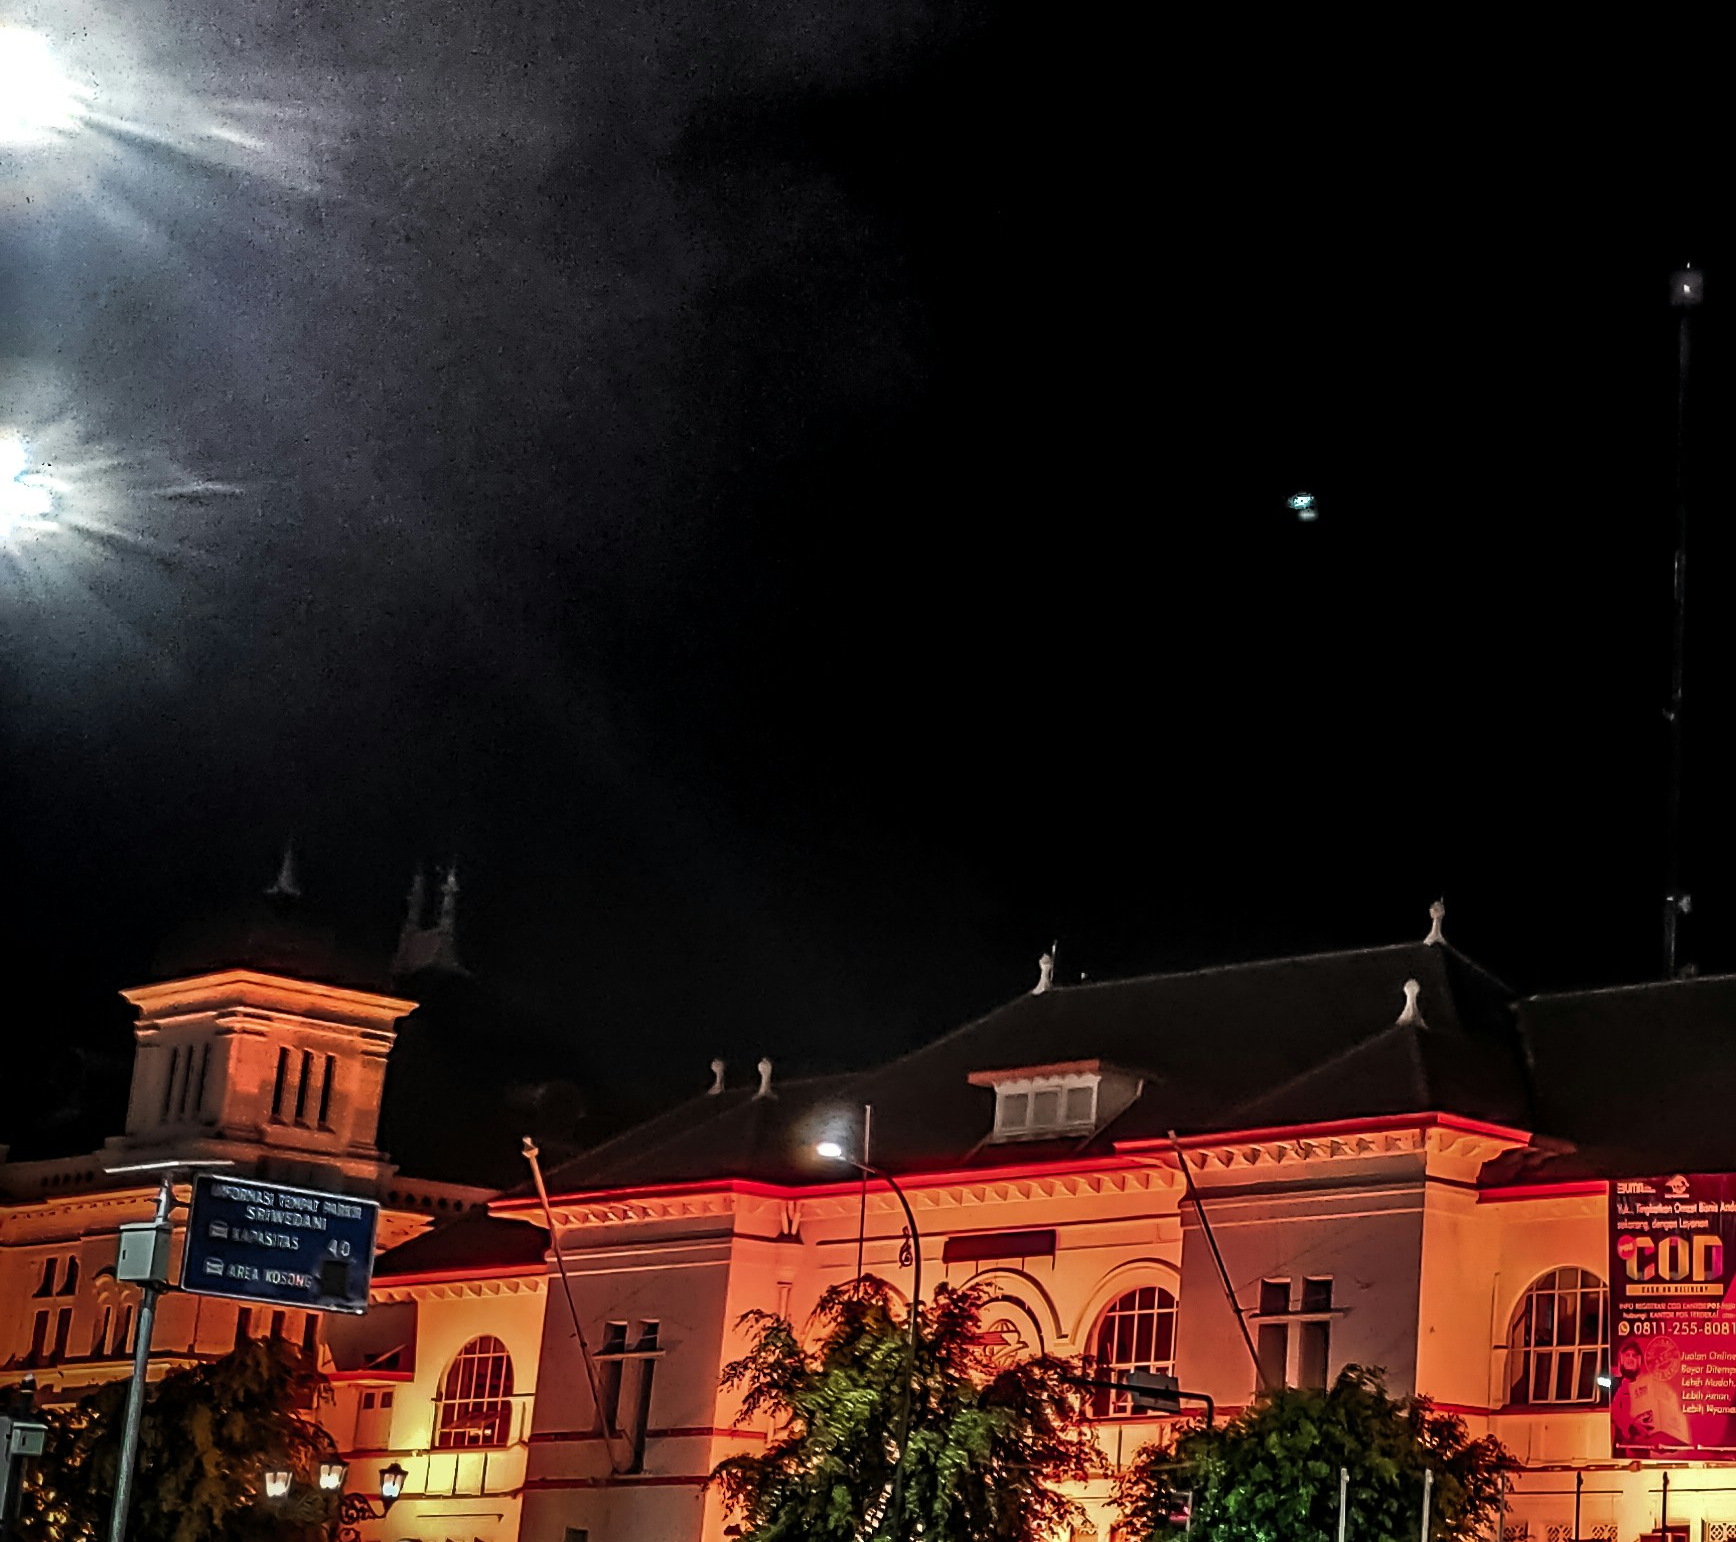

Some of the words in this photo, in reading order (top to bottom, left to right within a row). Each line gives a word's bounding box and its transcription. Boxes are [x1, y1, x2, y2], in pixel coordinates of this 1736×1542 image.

[245, 1205, 327, 1230] SRIWEDANI
[231, 1226, 300, 1250] KAPASITAS
[327, 1238, 351, 1258] 40
[1626, 1236, 1723, 1282] COD
[228, 1265, 259, 1282] AREA
[265, 1269, 313, 1289] KOSONG
[1633, 1322, 1736, 1336] 0811-255-8081
[1681, 1351, 1707, 1361] Jualan
[1681, 1364, 1704, 1376] Bayar
[1681, 1377, 1703, 1387] Lebih
[1682, 1390, 1704, 1400] Lebih
[1682, 1404, 1704, 1415] Lebih
